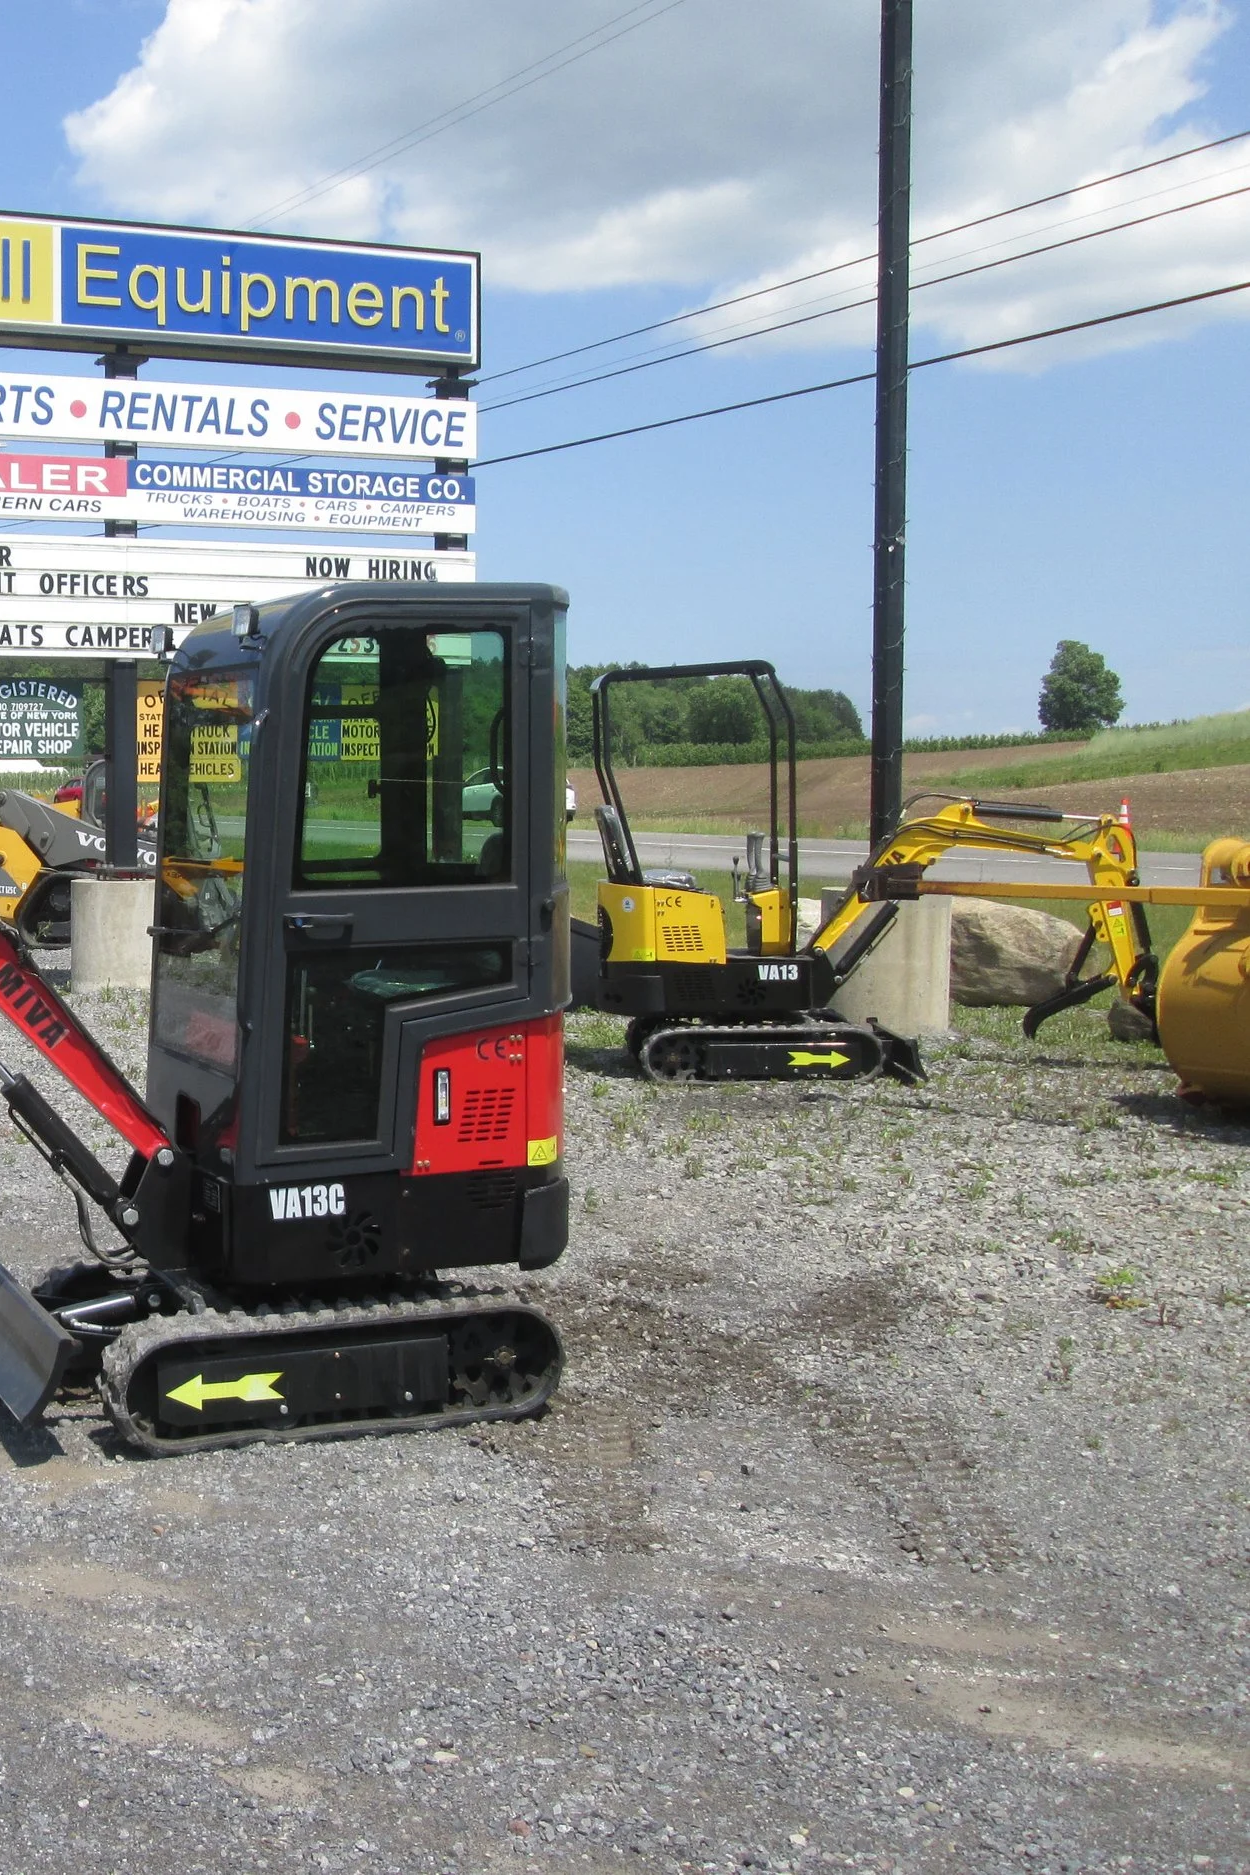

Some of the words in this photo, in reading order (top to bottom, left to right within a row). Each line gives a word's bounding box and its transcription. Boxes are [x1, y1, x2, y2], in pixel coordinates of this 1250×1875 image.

[76, 243, 450, 333] Equipment
[99, 390, 269, 437] RENTALS
[315, 403, 466, 447] SERVICE
[135, 465, 300, 492] COMMERCIAL
[308, 472, 419, 498] STORAGE
[427, 480, 466, 500] CO.
[49, 498, 102, 513] CARS
[146, 492, 213, 505] TRUCKS
[237, 496, 291, 509] BOATS
[315, 500, 357, 512] CARS
[381, 503, 456, 516] CAMPERS
[184, 508, 306, 523] WAREHOUSING
[329, 513, 423, 528] EQUIPMENT
[306, 556, 350, 577] NOW
[39, 573, 149, 597] OFFICERS
[174, 603, 216, 624] NEW
[11, 703, 44, 711] 7109727
[25, 722, 79, 738] VEHICLE
[37, 740, 72, 754] SHOP
[198, 741, 236, 755] STATION
[758, 964, 799, 981] VA13
[269, 1183, 346, 1220] VA13C
